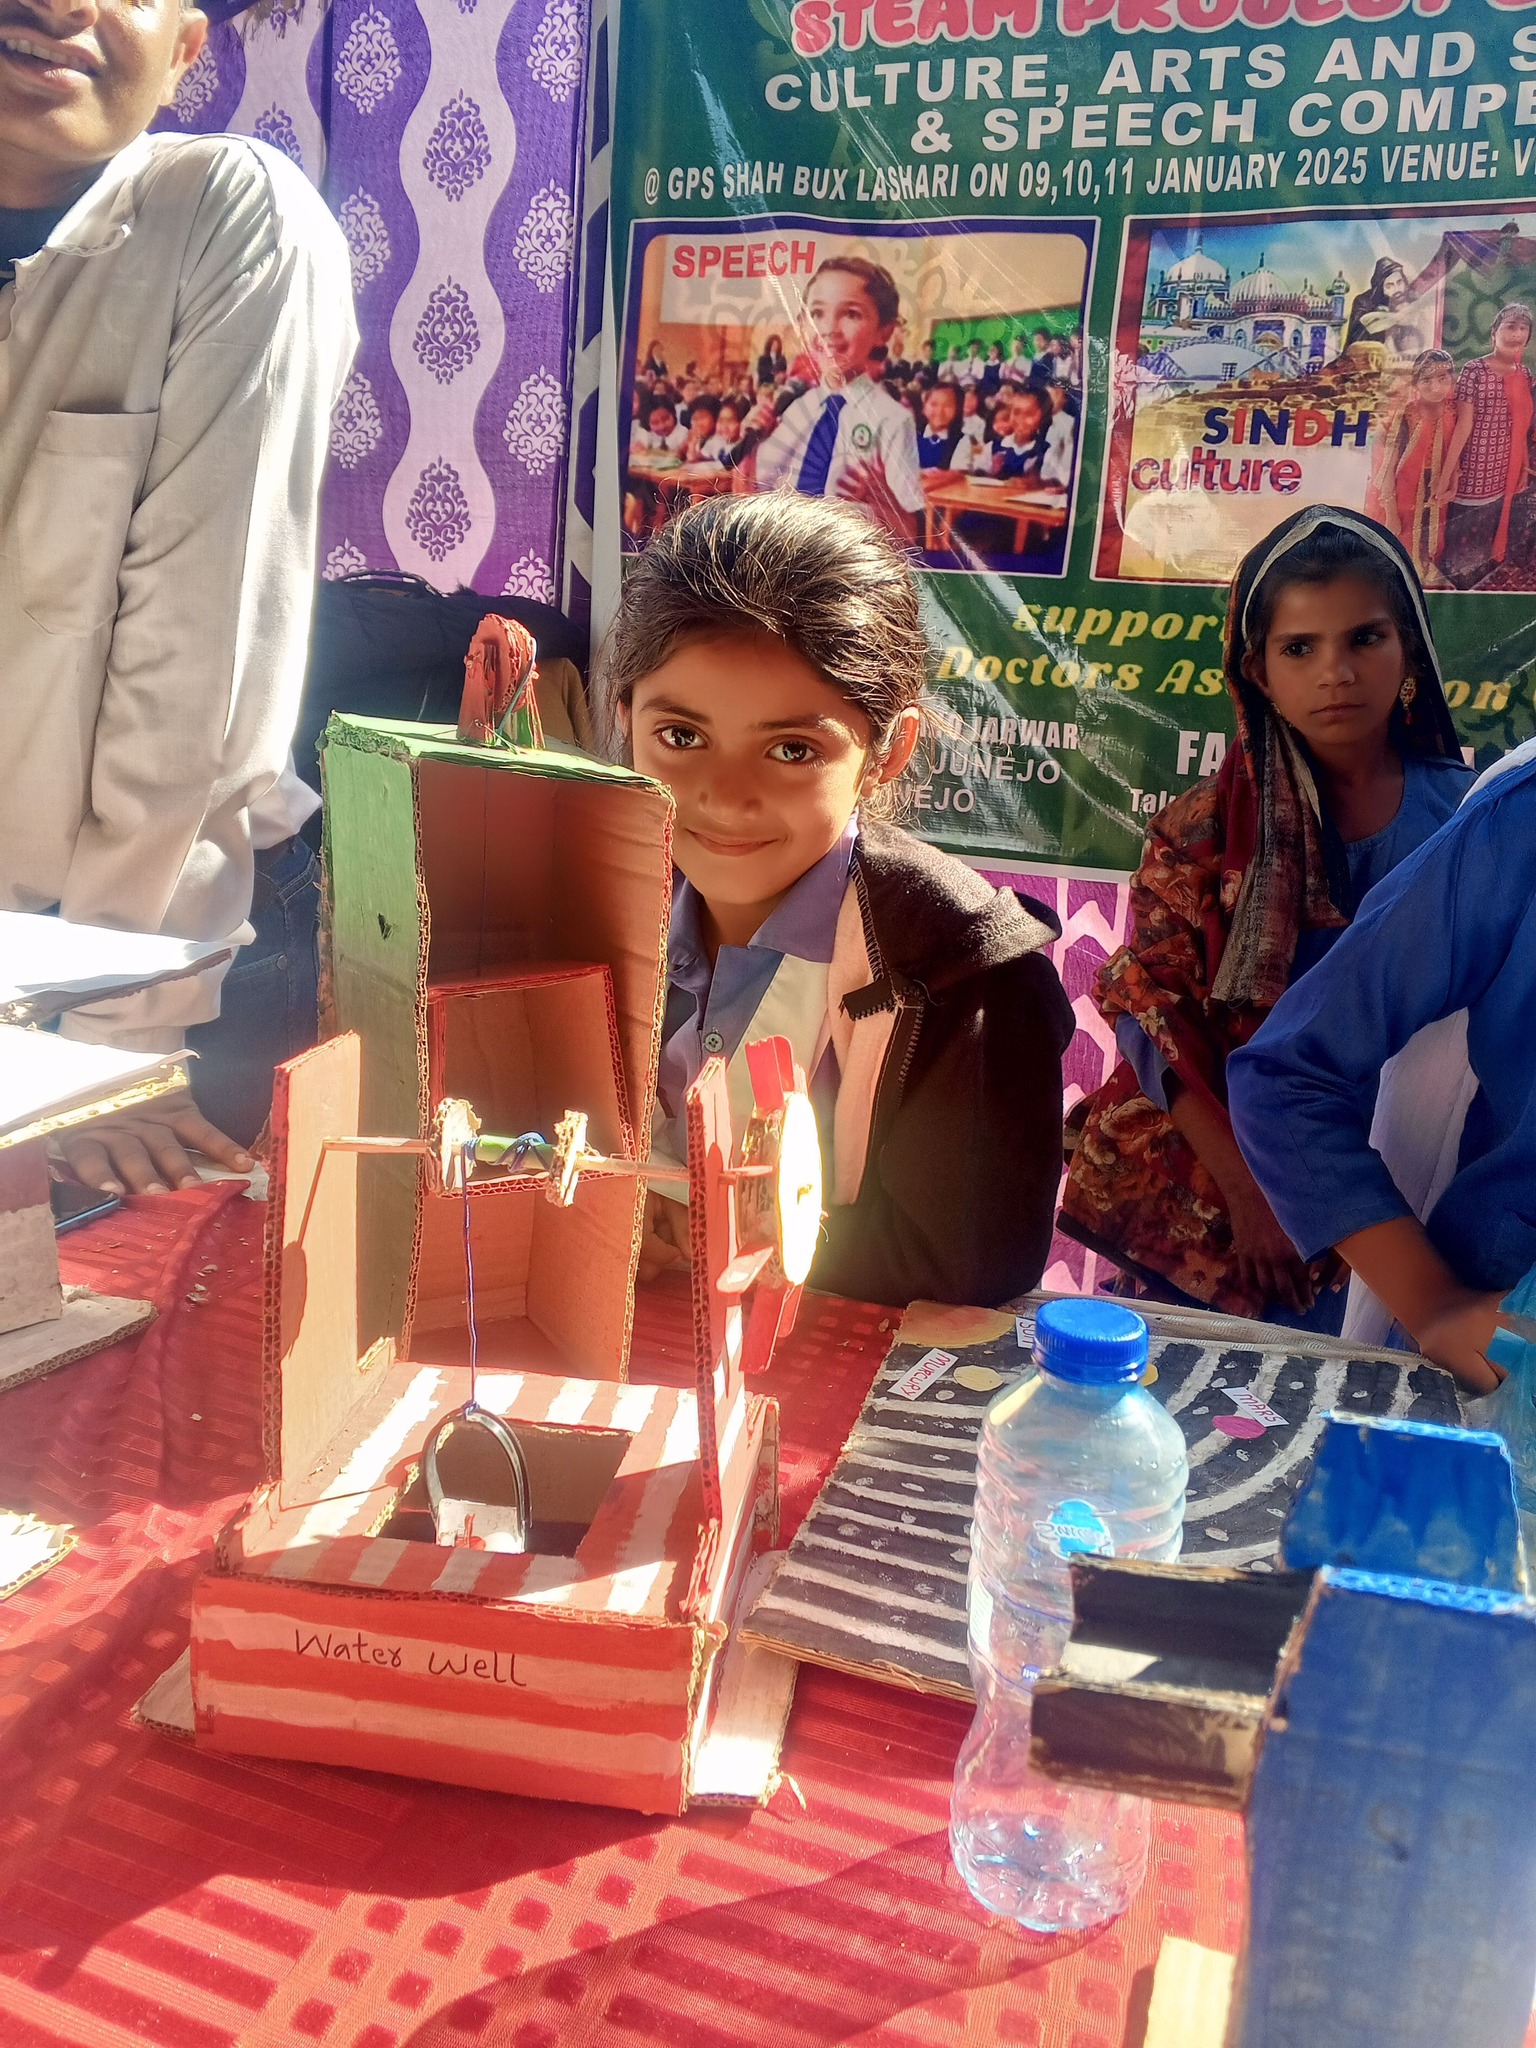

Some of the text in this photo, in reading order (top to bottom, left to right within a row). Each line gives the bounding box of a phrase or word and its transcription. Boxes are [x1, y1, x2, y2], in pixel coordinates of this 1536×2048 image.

[791, 0, 1043, 57] STEAM
[763, 54, 1070, 112] CULTURE,
[1097, 43, 1287, 95] ARTS
[1314, 31, 1476, 84] AND
[910, 110, 954, 154] &
[981, 98, 1257, 153] SPEECH
[644, 167, 660, 205] @
[667, 167, 714, 200] GPS
[723, 163, 784, 197] SHAH
[793, 165, 847, 201] BUX
[856, 164, 959, 201] LASHARI
[969, 162, 1009, 198] ON
[1018, 158, 1135, 206] 09,10,11
[1145, 151, 1287, 195] JANUARY
[1294, 147, 1368, 187] 2025
[1381, 140, 1499, 184] VENUE:
[672, 240, 816, 279] SPEECH
[1202, 407, 1371, 447] SINDH
[1131, 446, 1303, 492] culture
[936, 646, 1144, 691] Doctors
[1155, 659, 1227, 696] As
[932, 750, 1062, 784] JUNEJO
[295, 1628, 403, 1668] Water
